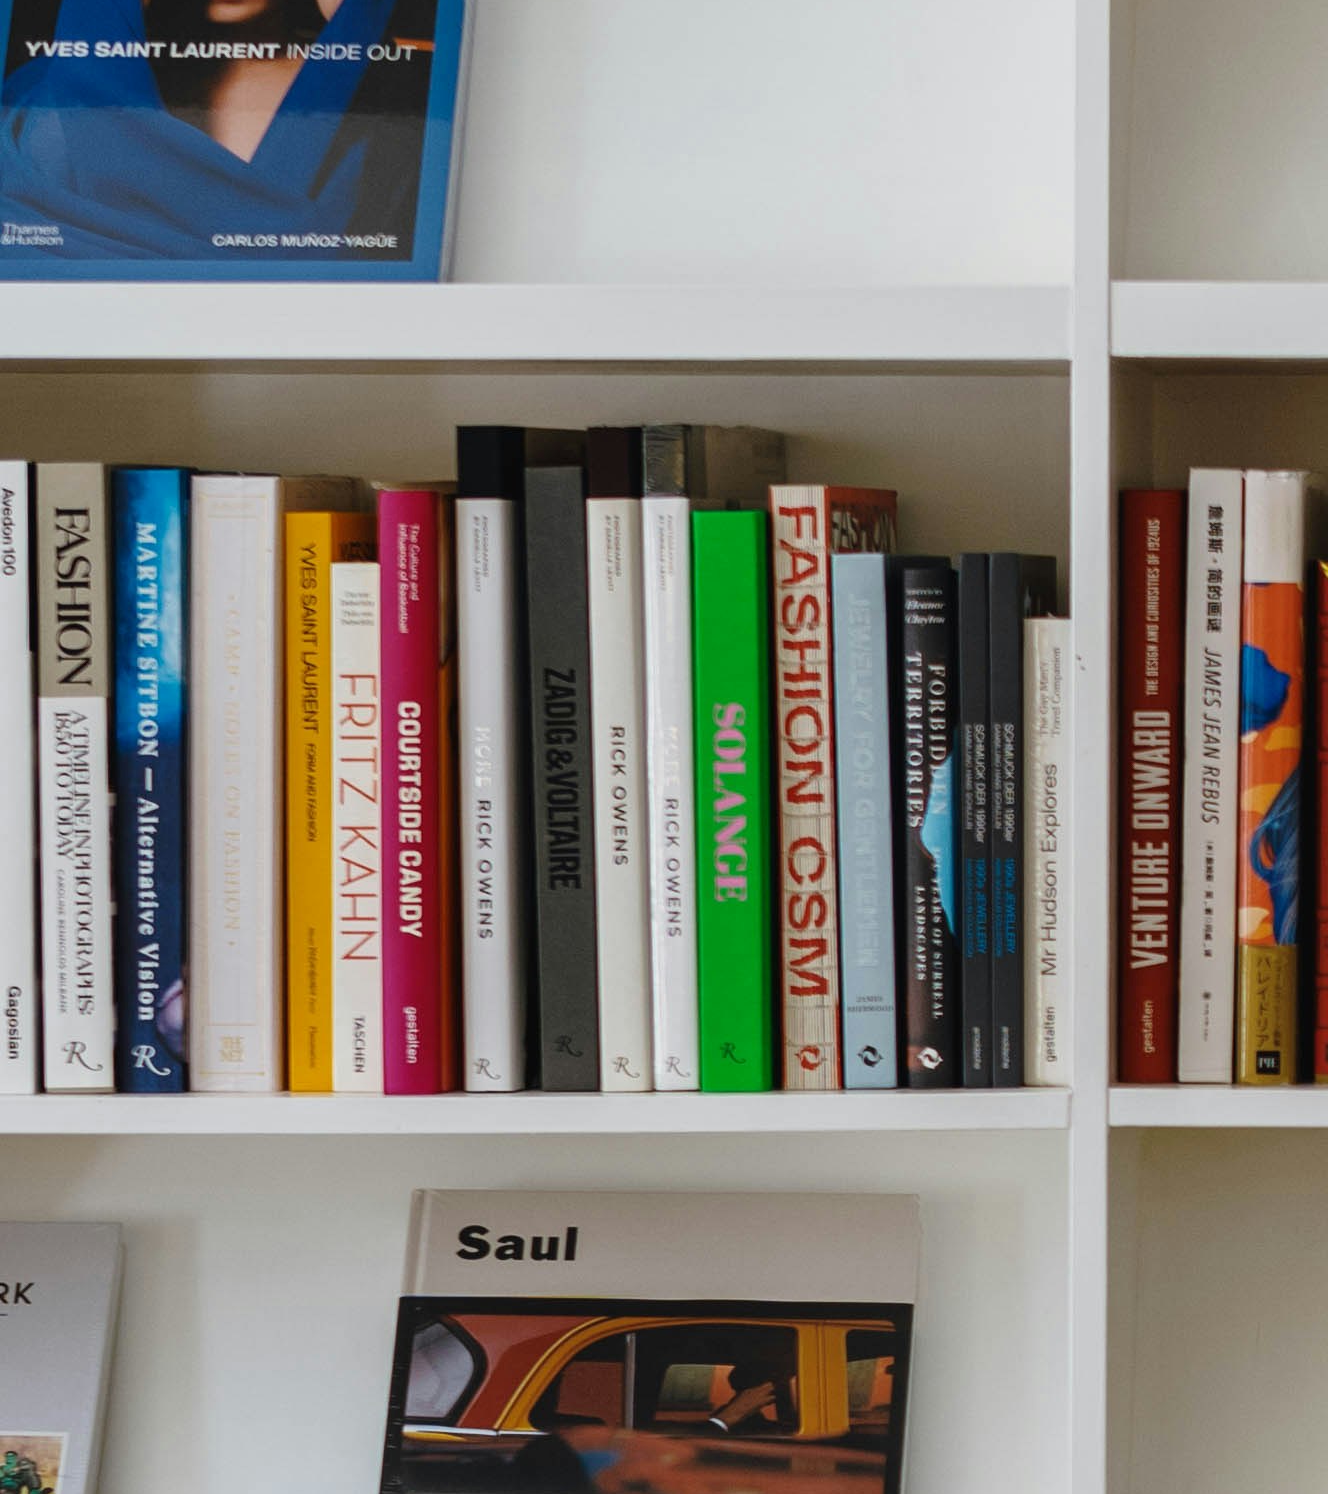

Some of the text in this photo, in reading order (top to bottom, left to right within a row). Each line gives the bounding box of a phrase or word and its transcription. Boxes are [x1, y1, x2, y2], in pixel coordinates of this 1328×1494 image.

[26, 42, 416, 60] YVES SAINT LAURENT INSIDE OUT
[213, 235, 278, 248] CARLOS
[57, 509, 91, 685] FASHION
[340, 675, 378, 962] FRITZ KAHN
[398, 702, 423, 935] COURTSIDE CANDY
[778, 506, 828, 997] FASHION CSM
[1131, 711, 1170, 970] VENTURE ONWARD
[1041, 763, 1060, 976] Mr Hudson Explores
[456, 1225, 578, 1263] Saul
